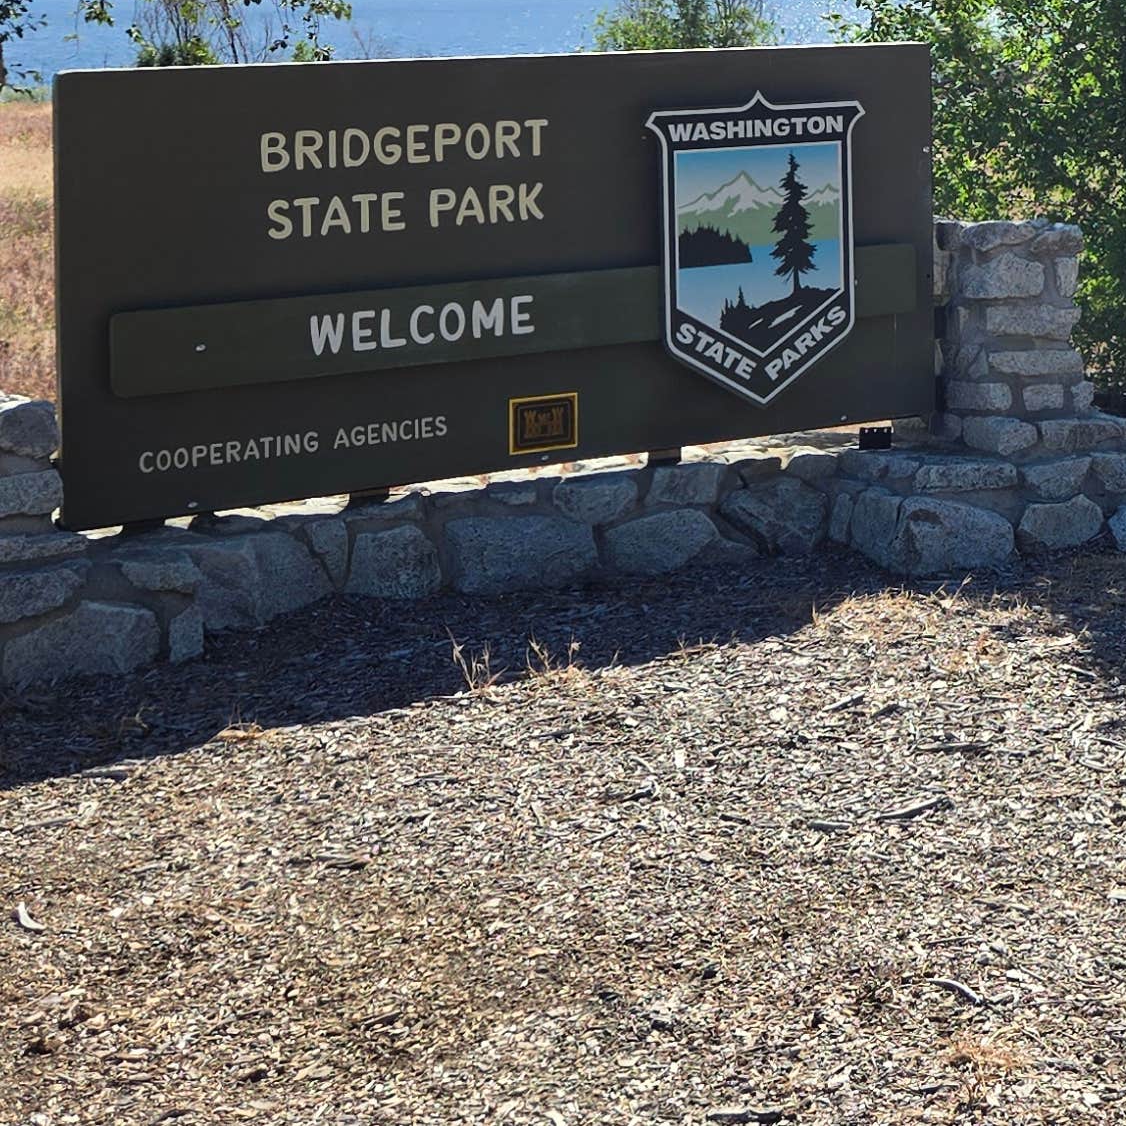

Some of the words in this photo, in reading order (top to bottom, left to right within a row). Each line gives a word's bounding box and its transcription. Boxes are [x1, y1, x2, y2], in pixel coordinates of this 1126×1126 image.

[259, 119, 549, 173] BRIDGEPORT
[667, 115, 845, 142] WASHINGTON
[266, 192, 406, 240] STATE
[429, 182, 545, 228] PARK
[309, 295, 536, 357] WELCOME
[675, 322, 758, 381] STATE
[763, 305, 848, 381] PARKS
[138, 431, 320, 474] COOPERATING
[333, 416, 449, 450] AGENCIES
